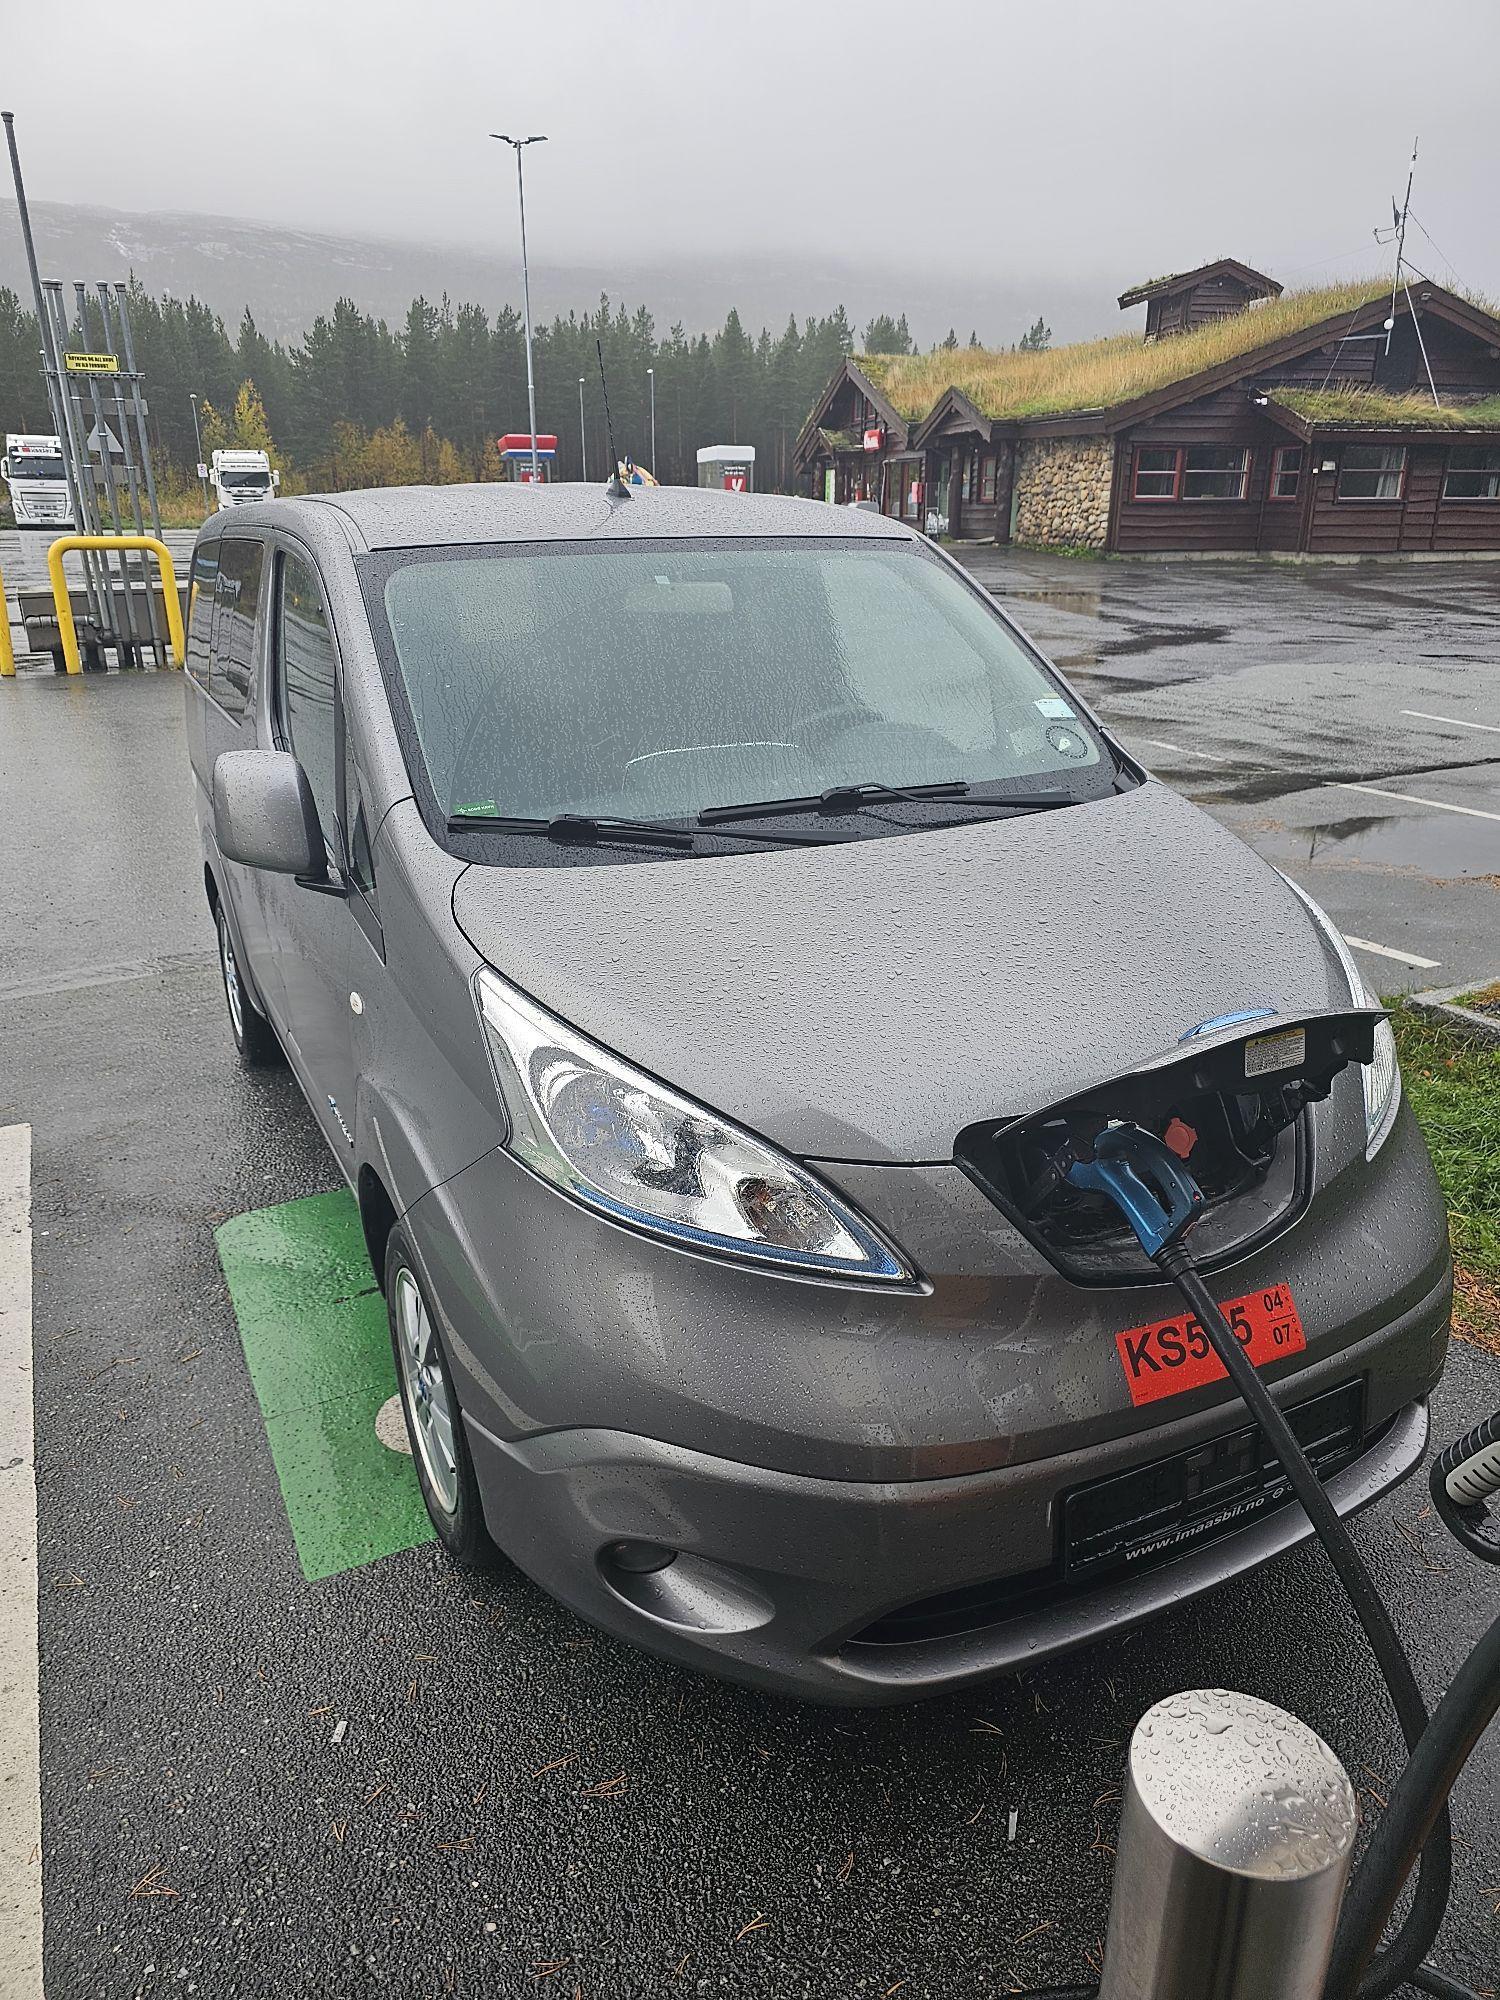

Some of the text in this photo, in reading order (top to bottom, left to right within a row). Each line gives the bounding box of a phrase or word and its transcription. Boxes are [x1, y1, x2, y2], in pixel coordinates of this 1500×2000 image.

[1264, 1290, 1283, 1312] 04
[1123, 1305, 1252, 1378] KS55
[1273, 1323, 1290, 1345] 07
[1125, 1497, 1265, 1560] www.imaasbil.no
